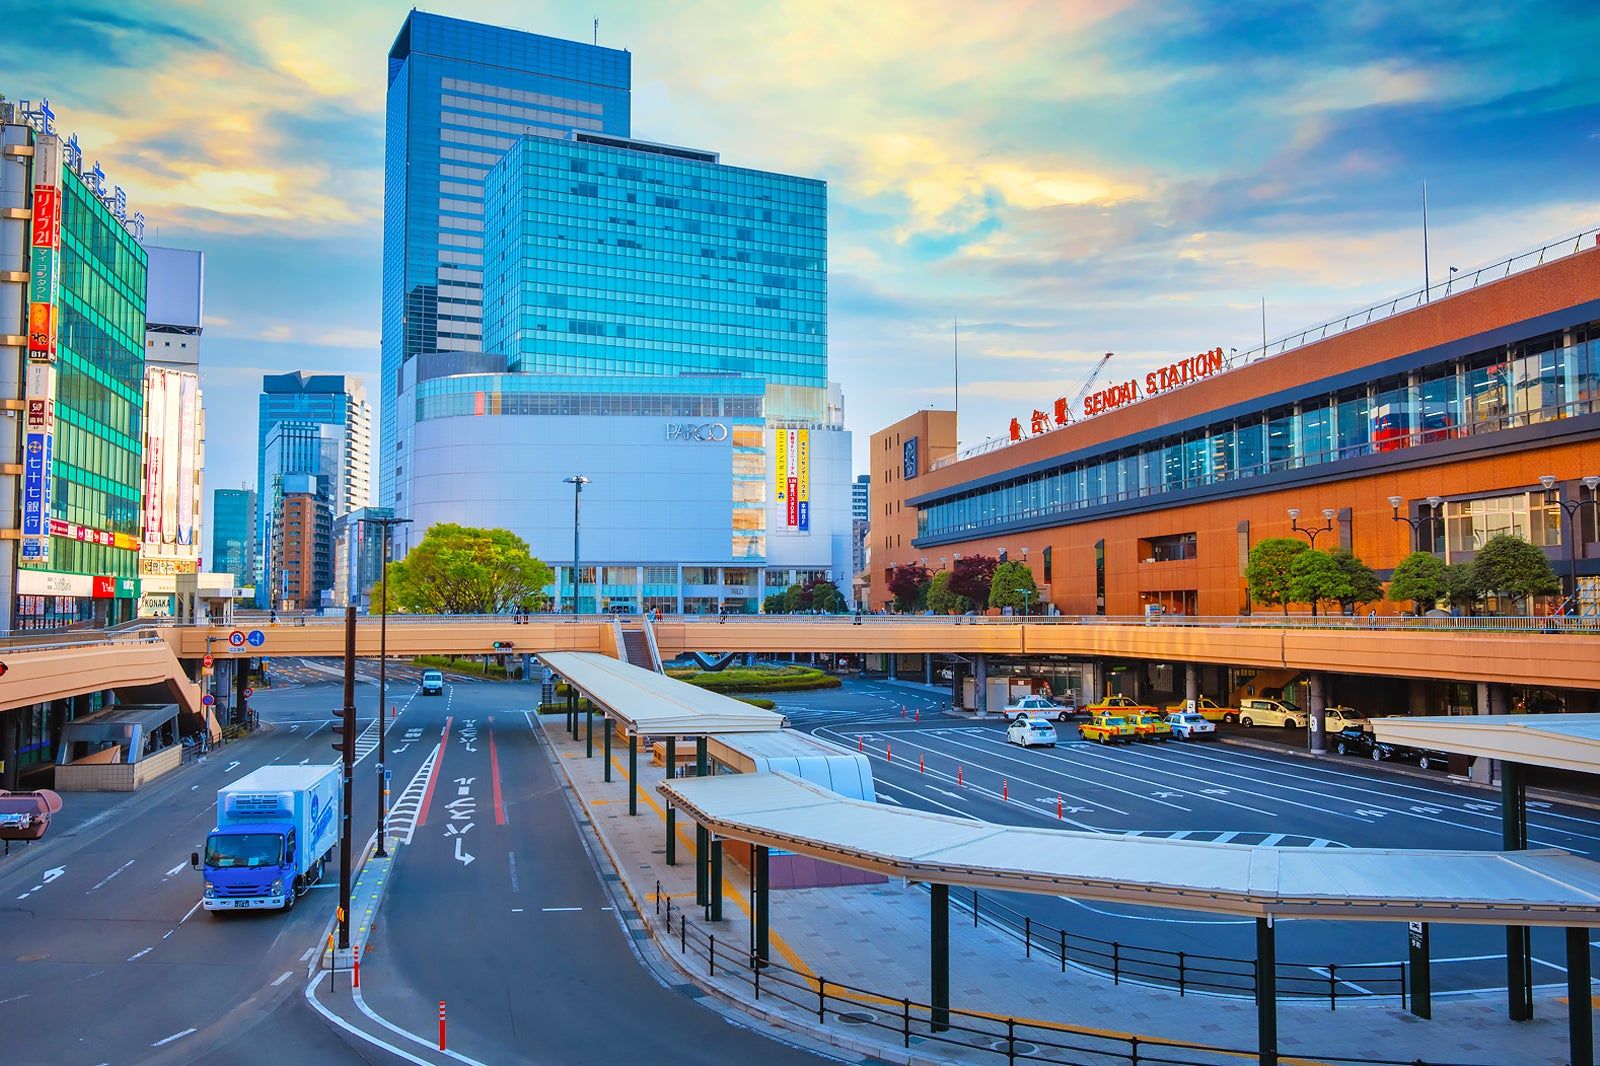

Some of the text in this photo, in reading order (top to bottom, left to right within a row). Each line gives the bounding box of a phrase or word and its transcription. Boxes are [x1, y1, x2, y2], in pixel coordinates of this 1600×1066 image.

[35, 193, 52, 245] リーブ21
[36, 248, 48, 300] マイコンタクト
[30, 350, 48, 358] B1F
[1084, 346, 1223, 415] SENDAI STATION
[665, 422, 728, 441] PARCO
[26, 457, 41, 528] 七十七銀行
[144, 599, 171, 608] KONAKA
[444, 777, 477, 837] バスプール
